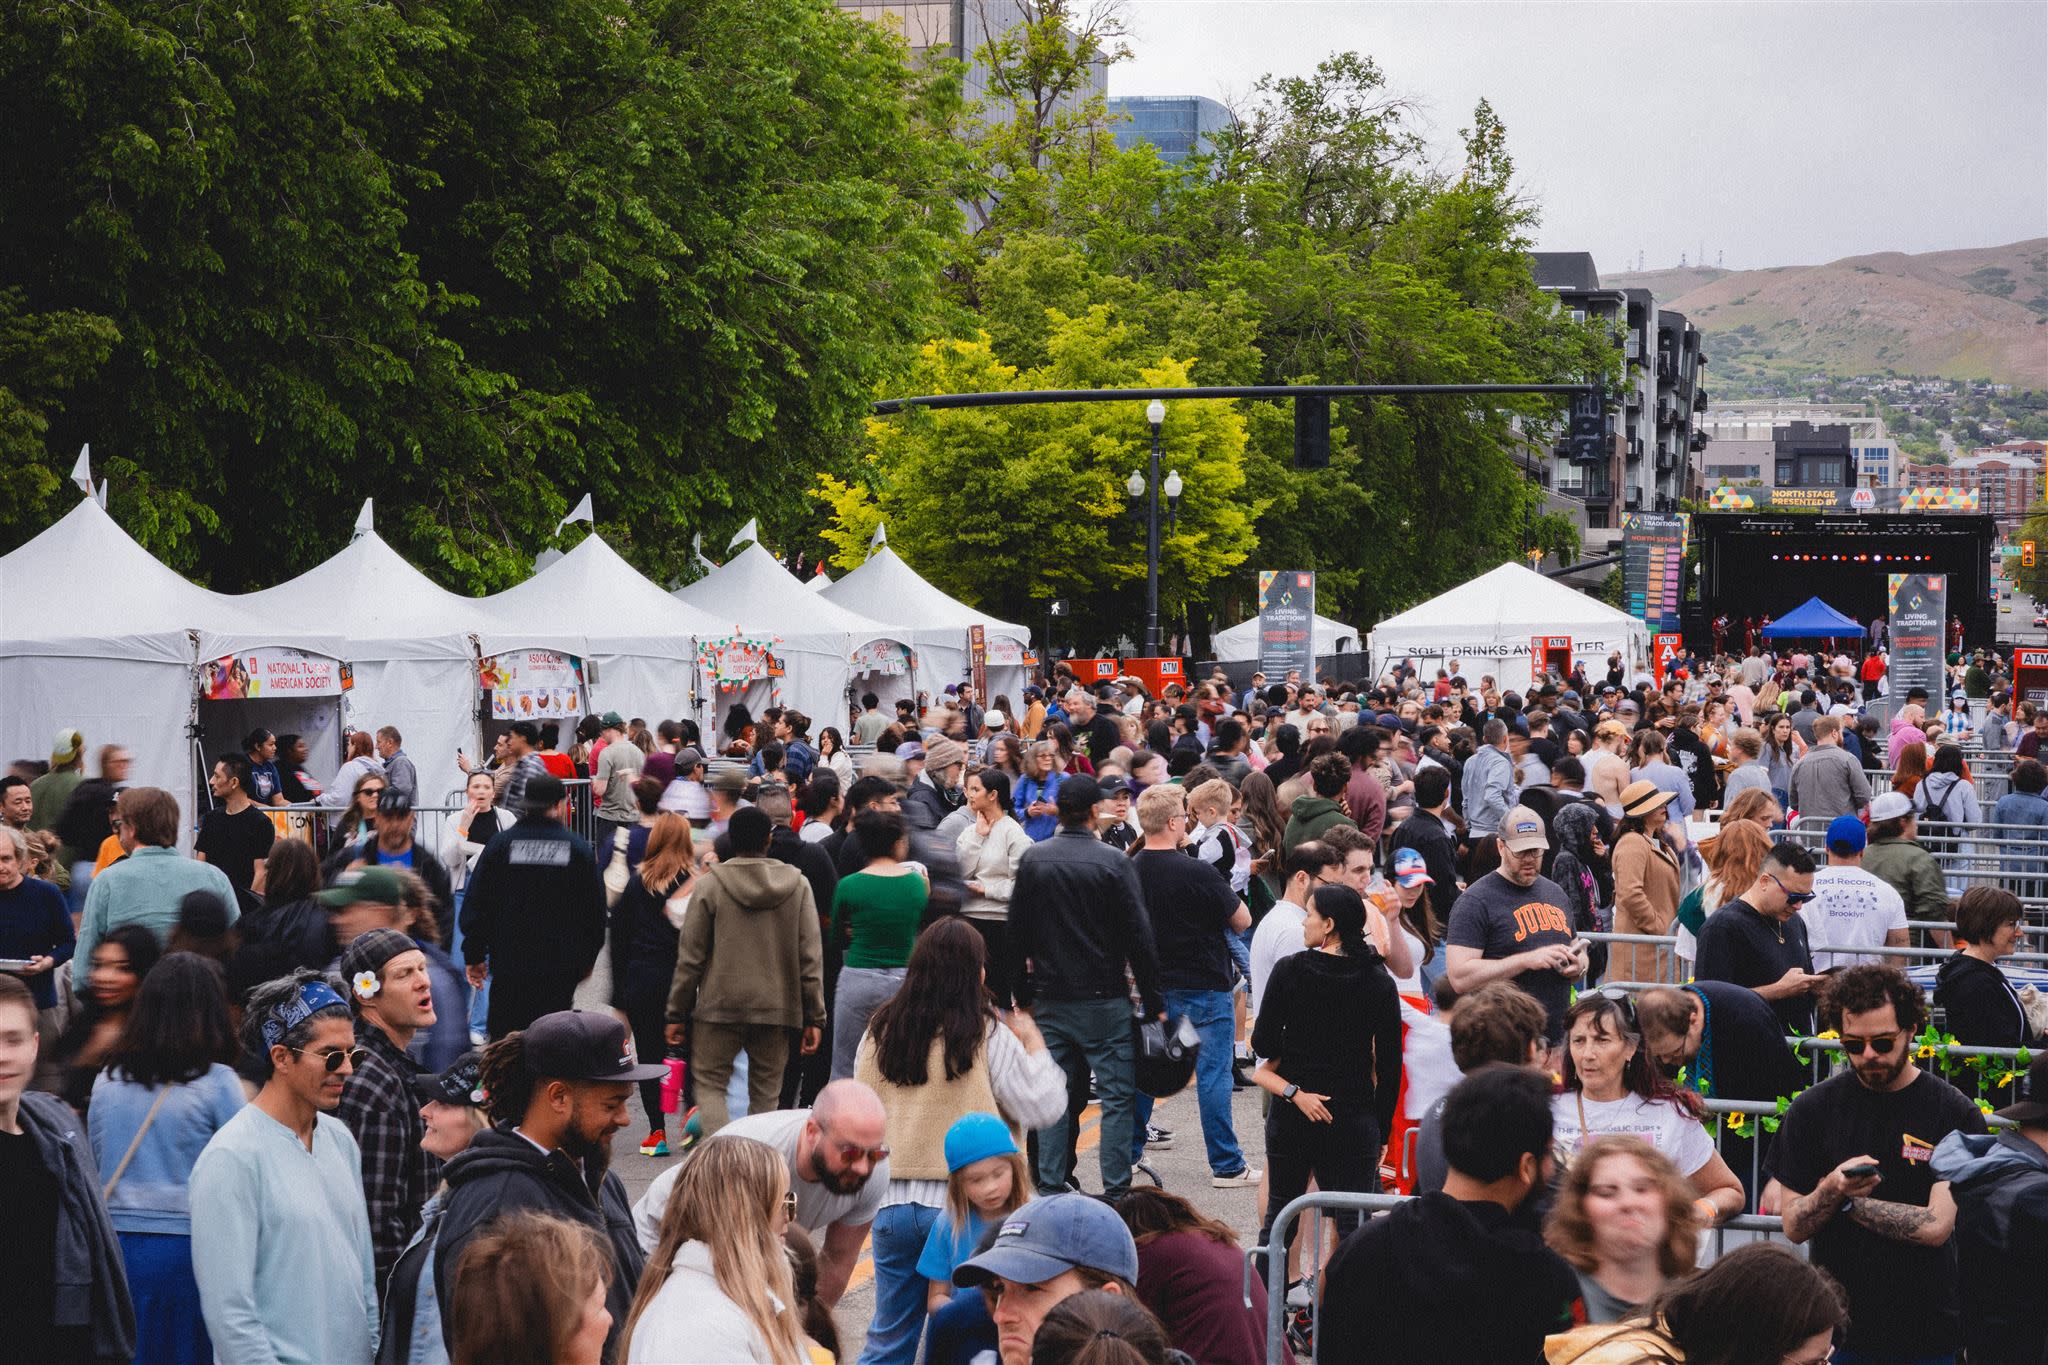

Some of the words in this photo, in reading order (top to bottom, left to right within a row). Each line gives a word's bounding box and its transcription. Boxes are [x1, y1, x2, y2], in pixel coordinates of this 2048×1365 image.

[1772, 490, 1805, 498] NORTH
[1806, 490, 1836, 498] STAGE
[1772, 498, 1824, 506] PRESENTED
[1452, 645, 1508, 656] DRINKS
[1513, 645, 1532, 655] AN
[267, 663, 301, 674] NATIONAL
[1098, 663, 1113, 674] ATM
[1162, 662, 1178, 673] ATM
[271, 678, 305, 689] AMERICAN
[305, 676, 332, 689] SOCIETY
[1816, 877, 1835, 886] Rad
[1837, 878, 1876, 888] Records
[1829, 909, 1865, 918] Brooklyn
[1513, 902, 1572, 943] JUDGE
